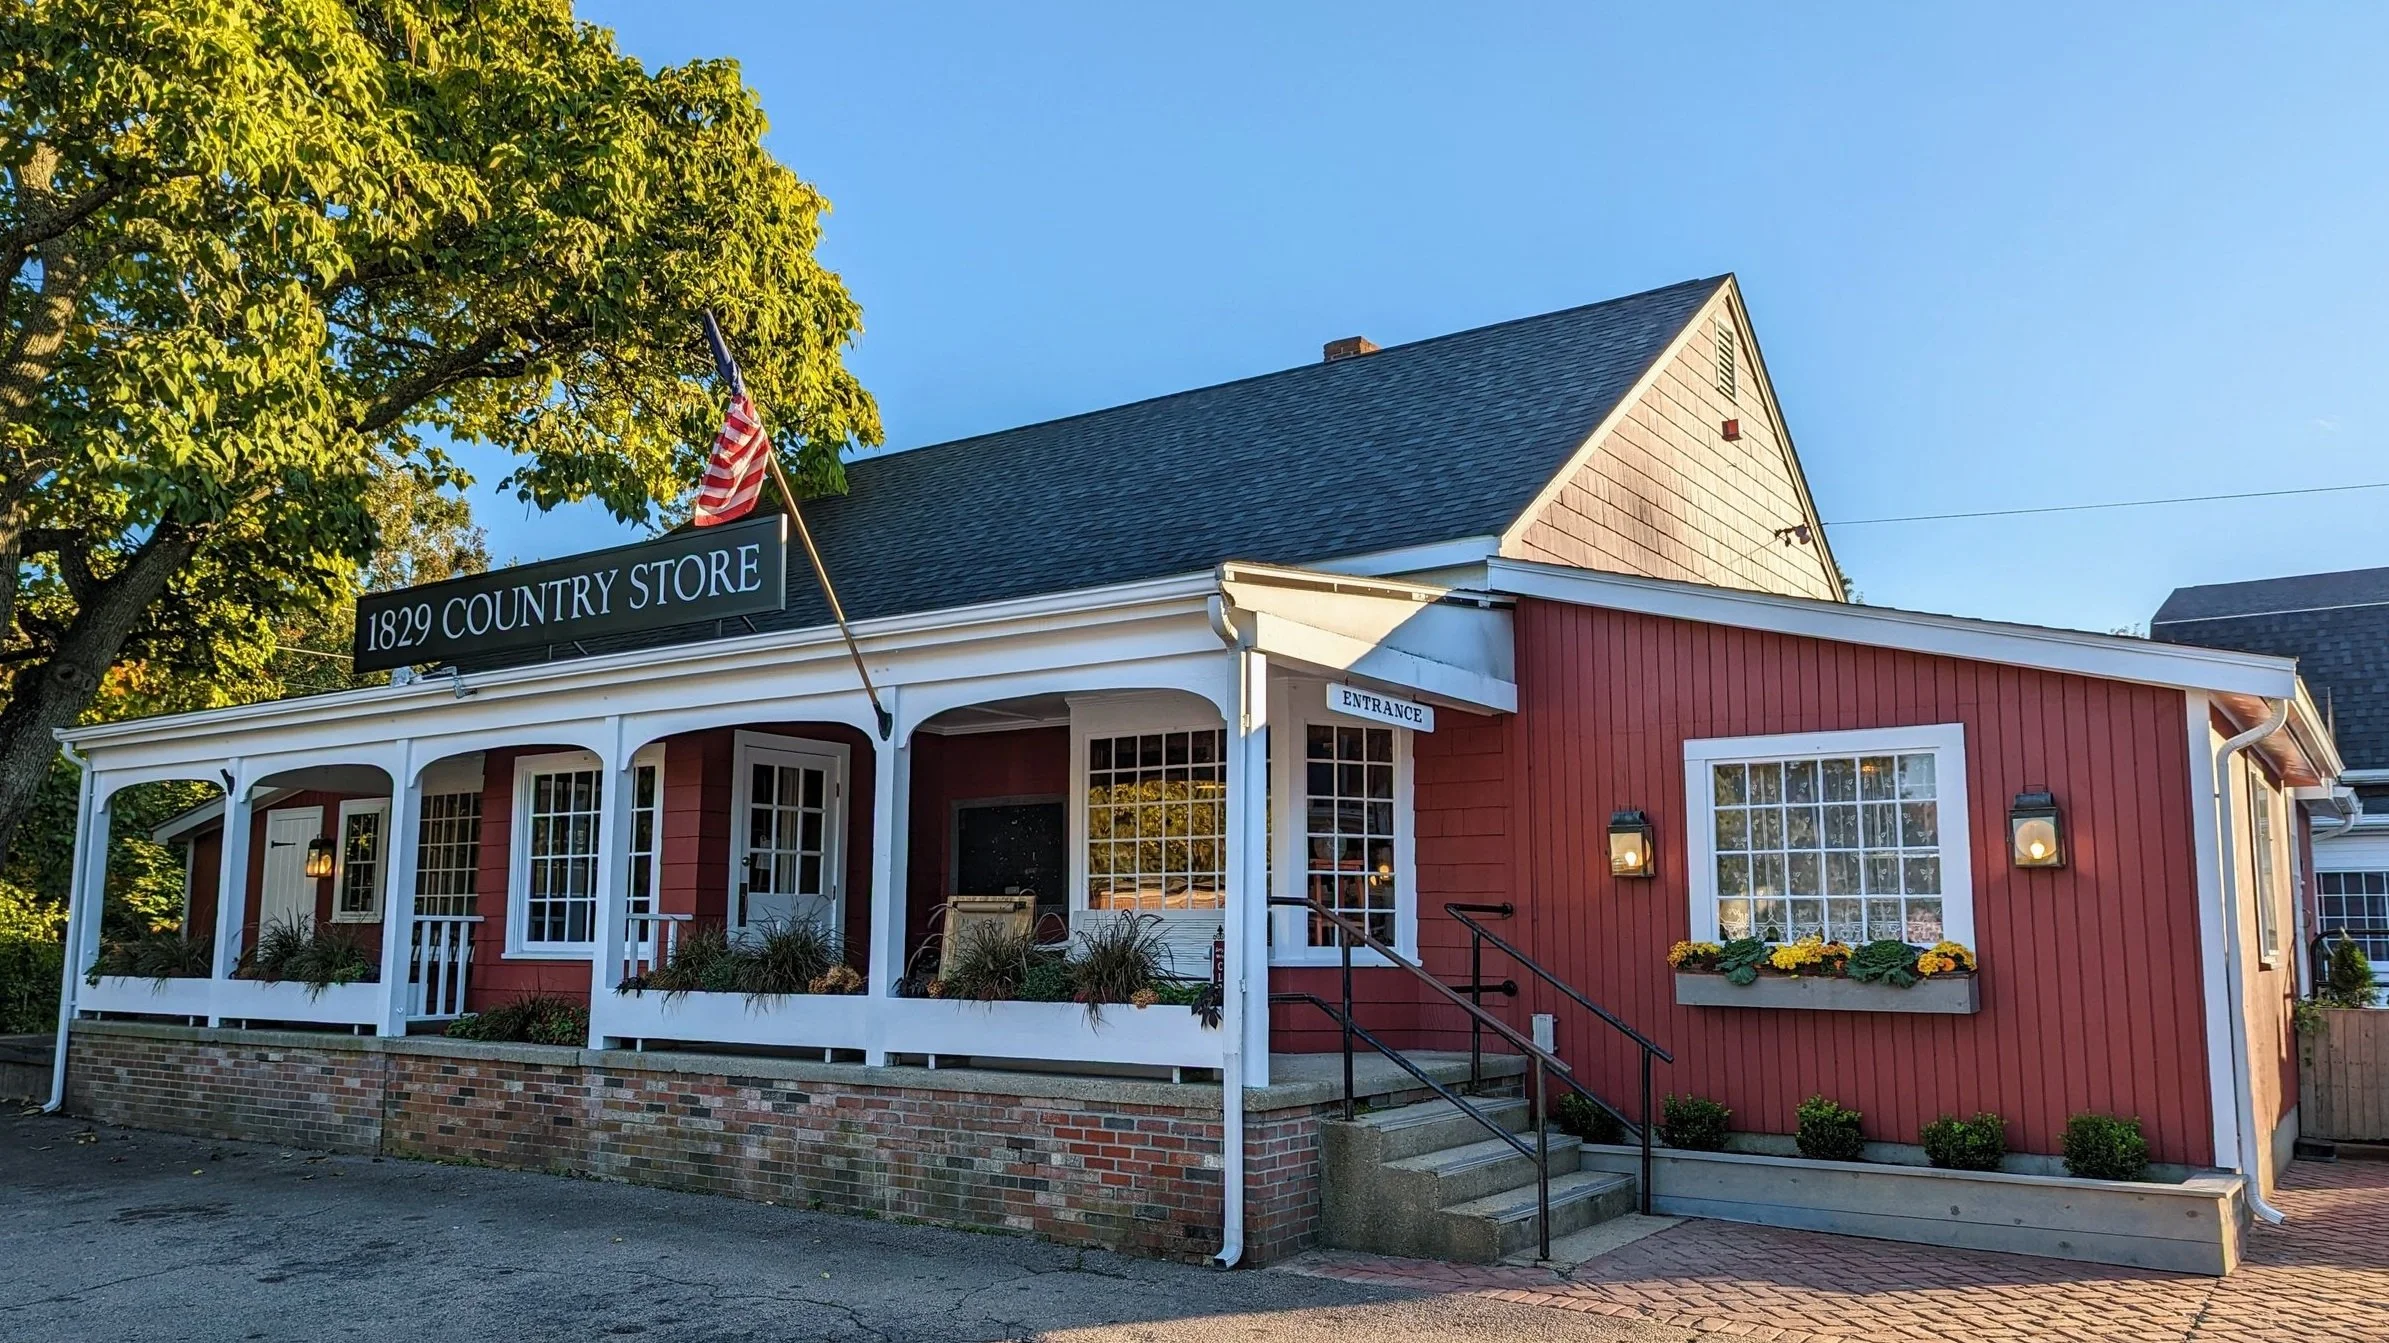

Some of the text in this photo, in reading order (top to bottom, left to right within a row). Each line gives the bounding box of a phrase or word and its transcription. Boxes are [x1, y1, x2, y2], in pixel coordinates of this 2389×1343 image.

[367, 543, 762, 652] 1829 COUNTRY STORE
[1342, 690, 1423, 724] ENTRANCE
